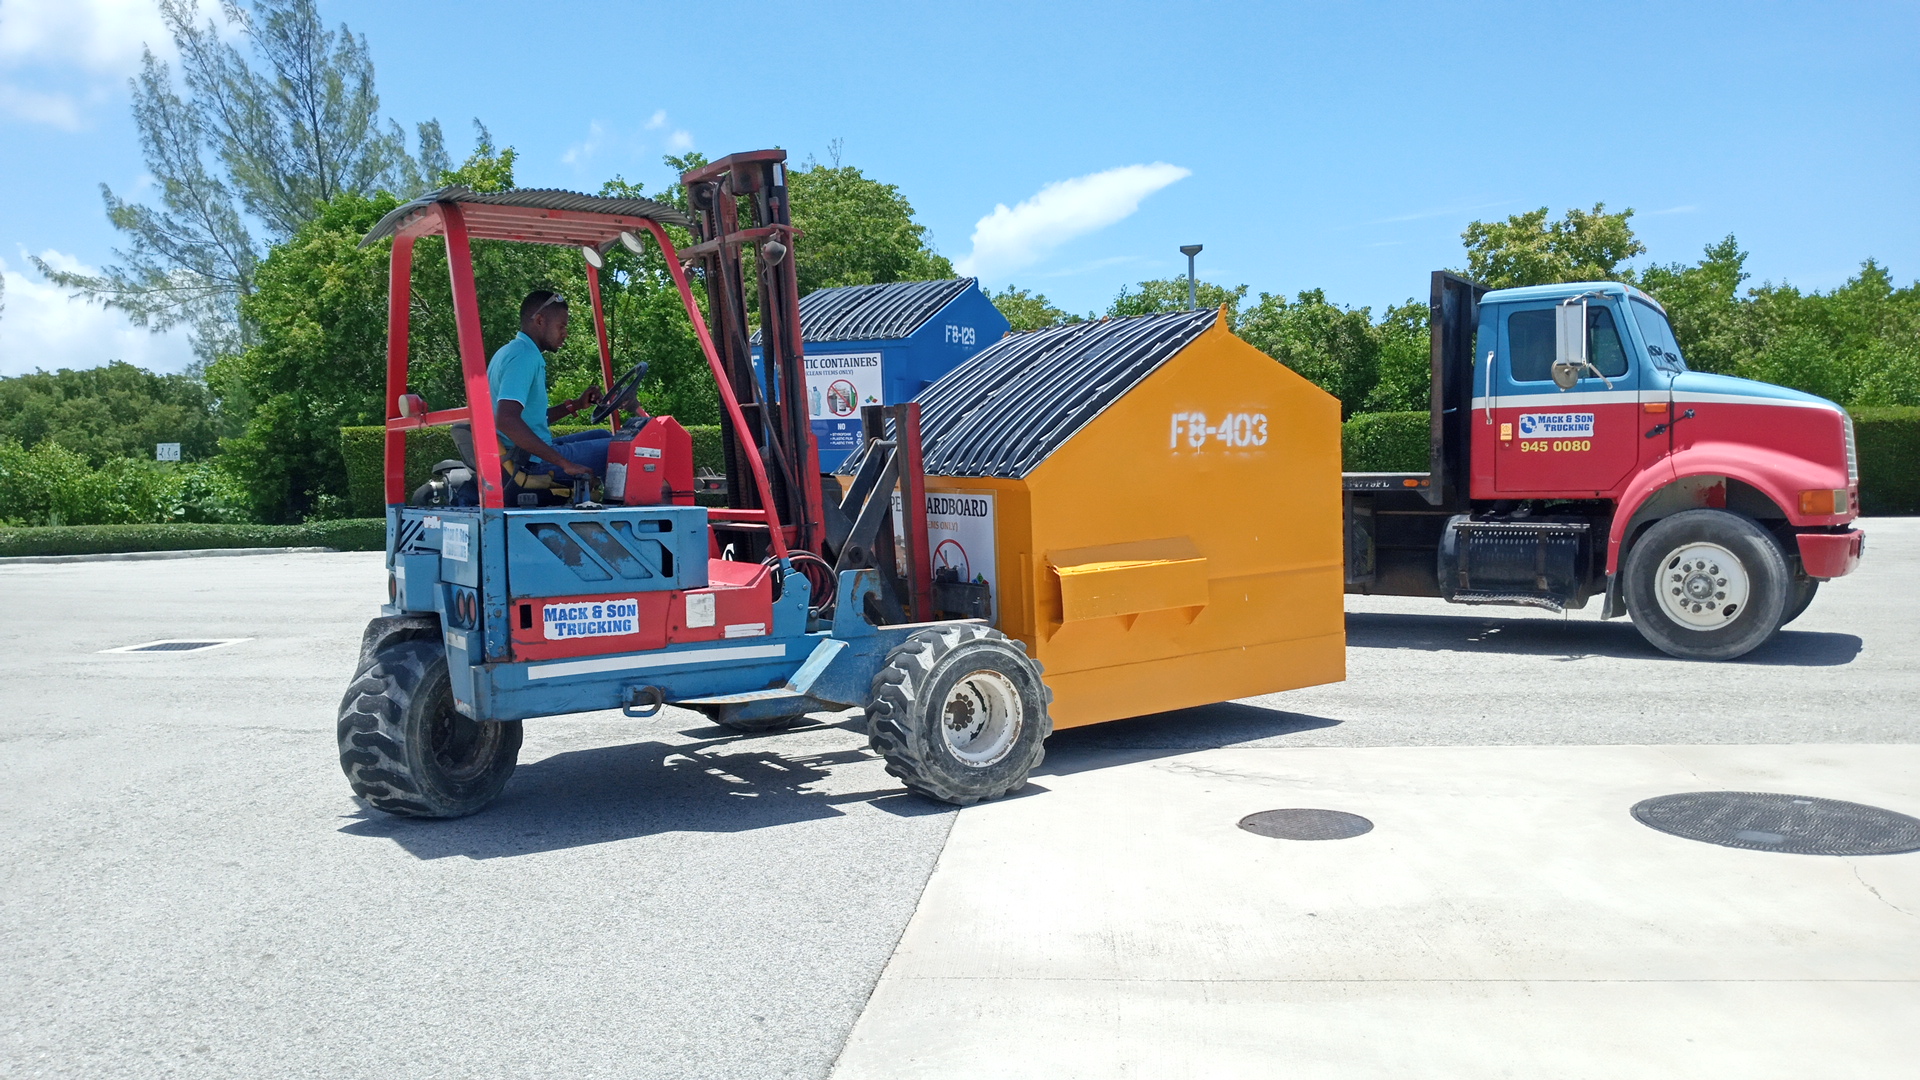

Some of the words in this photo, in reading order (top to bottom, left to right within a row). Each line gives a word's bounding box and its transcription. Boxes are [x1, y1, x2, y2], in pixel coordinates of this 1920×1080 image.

[945, 324, 976, 345] F8-129
[804, 359, 818, 369] TIC
[820, 357, 878, 369] CONTAINERS
[1538, 415, 1564, 424] MACK
[1566, 415, 1574, 423] &
[1575, 414, 1593, 423] SON
[1170, 412, 1268, 448] F8-403
[1544, 423, 1590, 432] TRUCKING
[1520, 441, 1549, 452] 945
[1553, 440, 1591, 452] 0080
[926, 497, 987, 517] ARDBOARD
[927, 521, 939, 530] EMS
[544, 605, 588, 622] MACK
[591, 604, 603, 619] &
[606, 603, 637, 618] SON
[555, 619, 632, 637] TRUCKING
